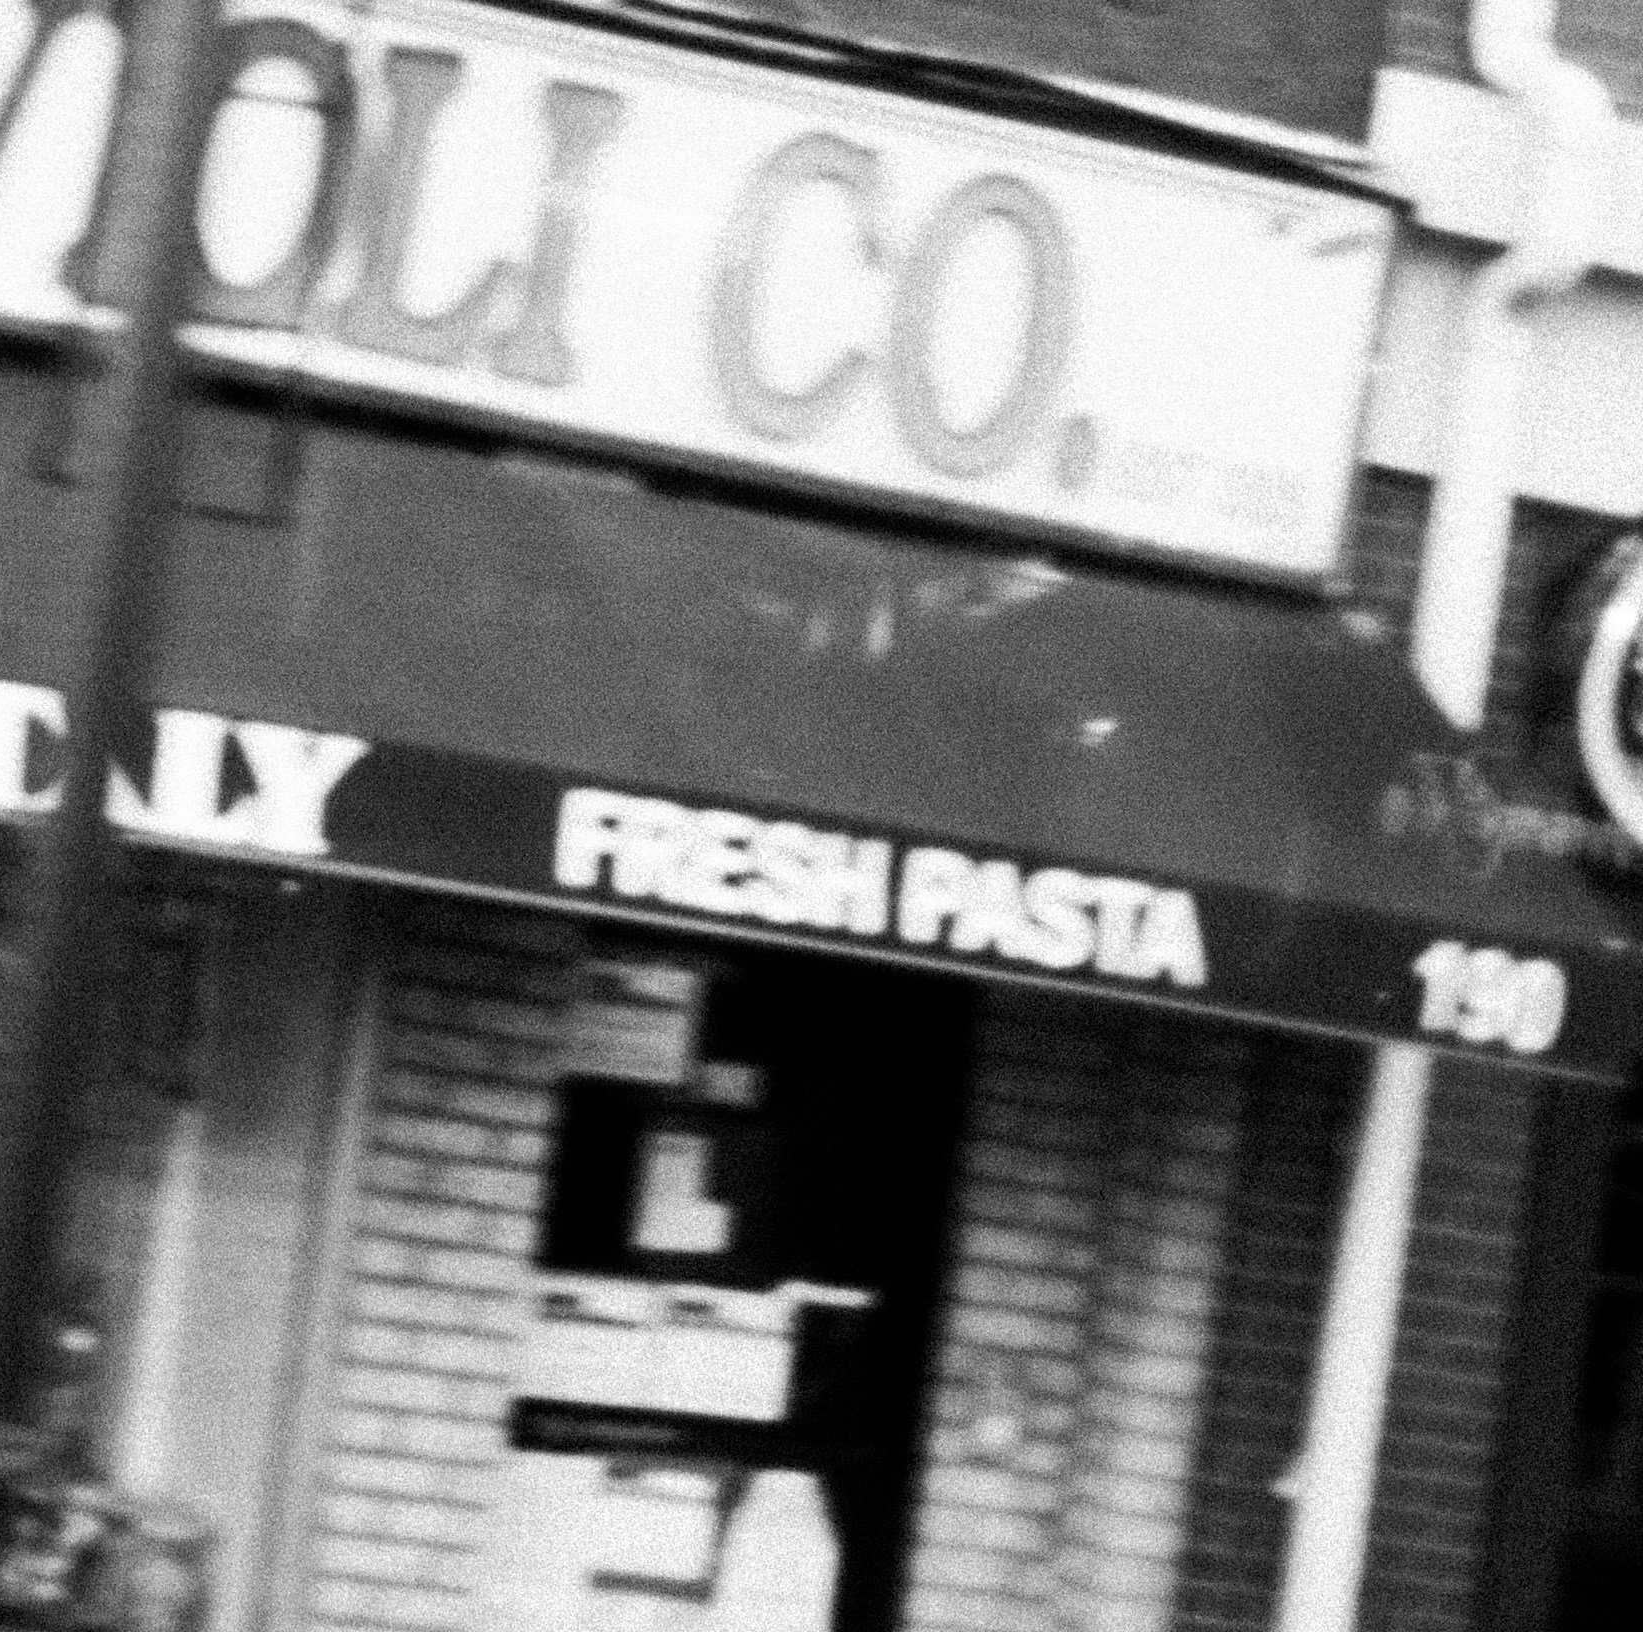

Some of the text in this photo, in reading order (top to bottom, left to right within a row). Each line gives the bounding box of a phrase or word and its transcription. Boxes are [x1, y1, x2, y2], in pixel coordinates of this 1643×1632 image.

[717, 130, 1099, 492] CO.
[555, 786, 1207, 988] FRESH PASTA
[1414, 940, 1566, 1052] 190
